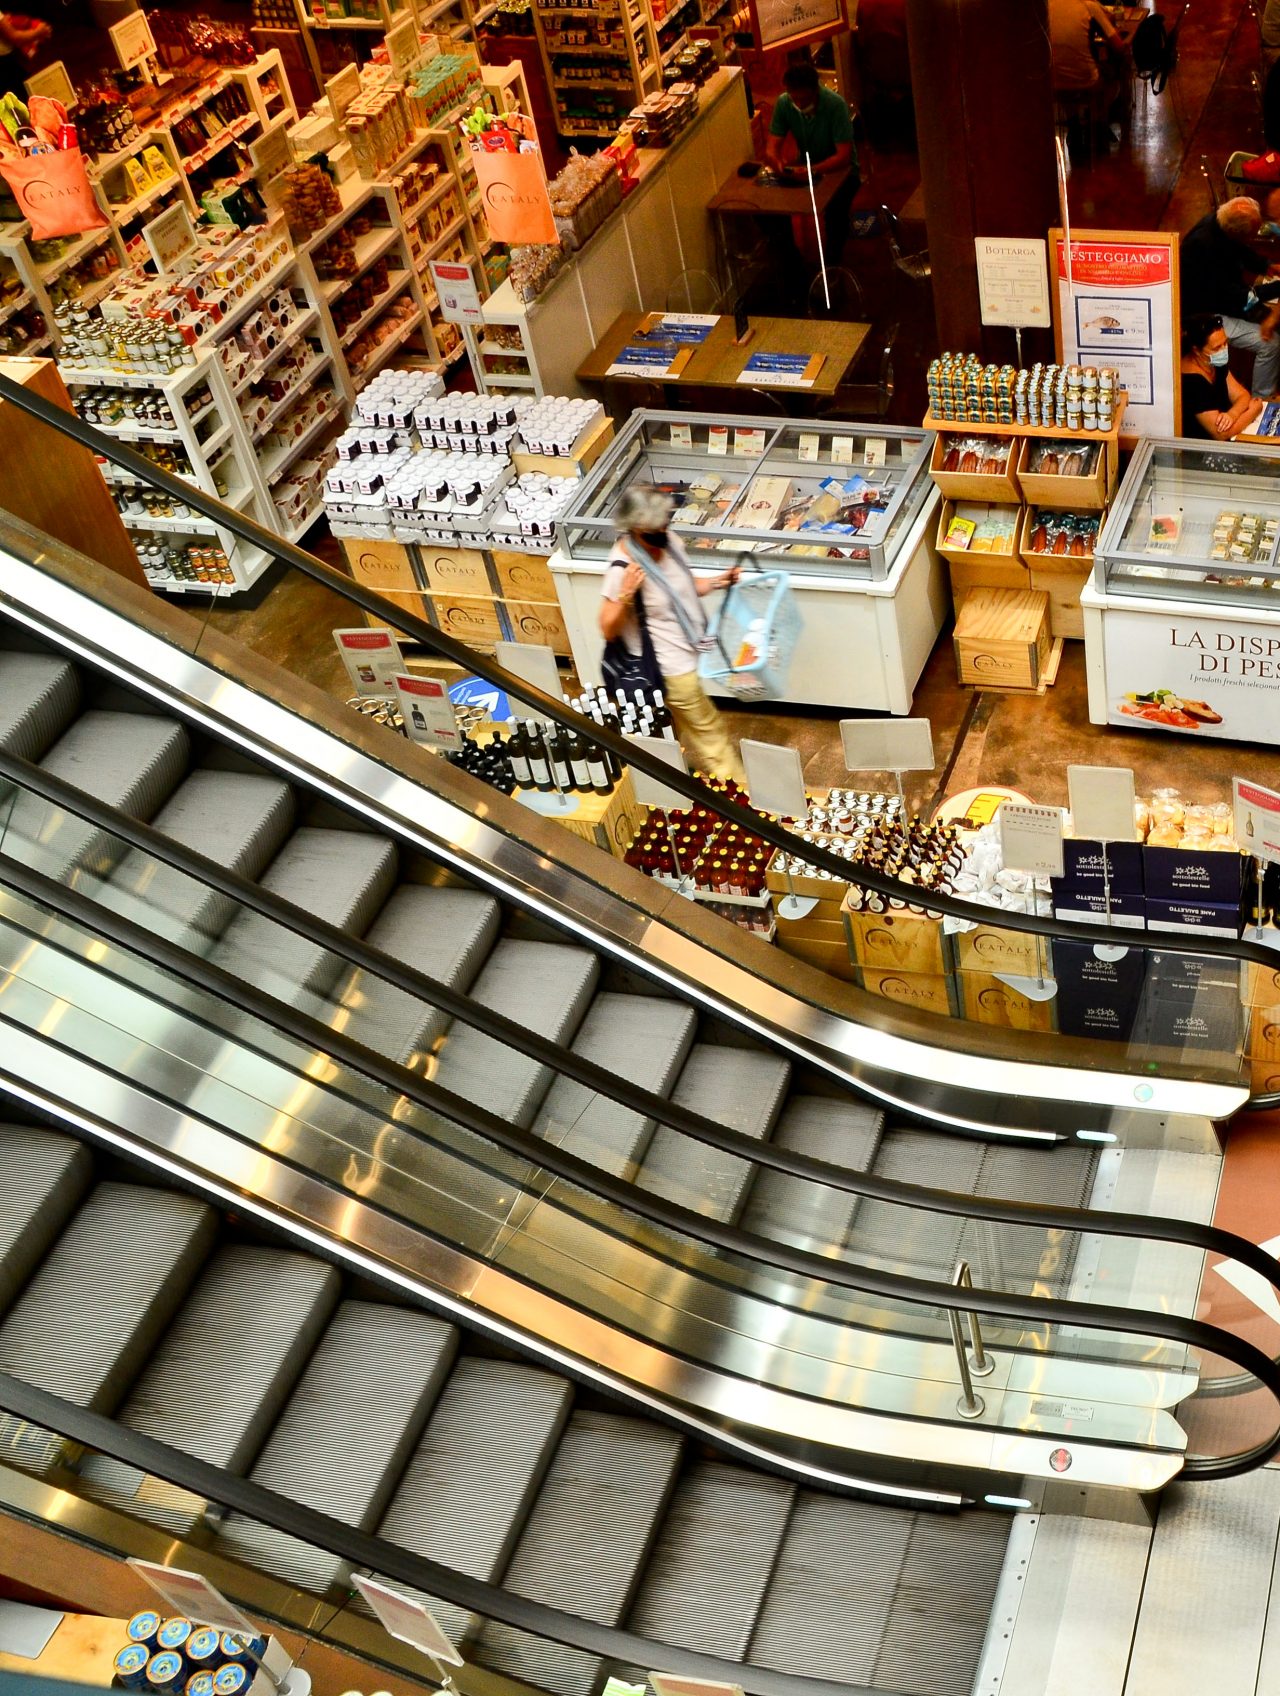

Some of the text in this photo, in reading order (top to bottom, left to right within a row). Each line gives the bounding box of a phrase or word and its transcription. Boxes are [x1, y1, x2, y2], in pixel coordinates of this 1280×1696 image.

[29, 185, 81, 202] EATALY
[491, 194, 541, 205] EATALY
[362, 560, 401, 571] EATALY
[438, 565, 478, 575] EATALY
[1169, 628, 1207, 649] LA
[1198, 653, 1230, 674] DI
[1193, 675, 1222, 685] prodotti
[1222, 679, 1246, 689] freschi
[1076, 863, 1114, 871] sottolestele
[979, 943, 1032, 955] EATALY
[885, 986, 935, 998] EATALY
[984, 996, 1034, 1009] EATALY
